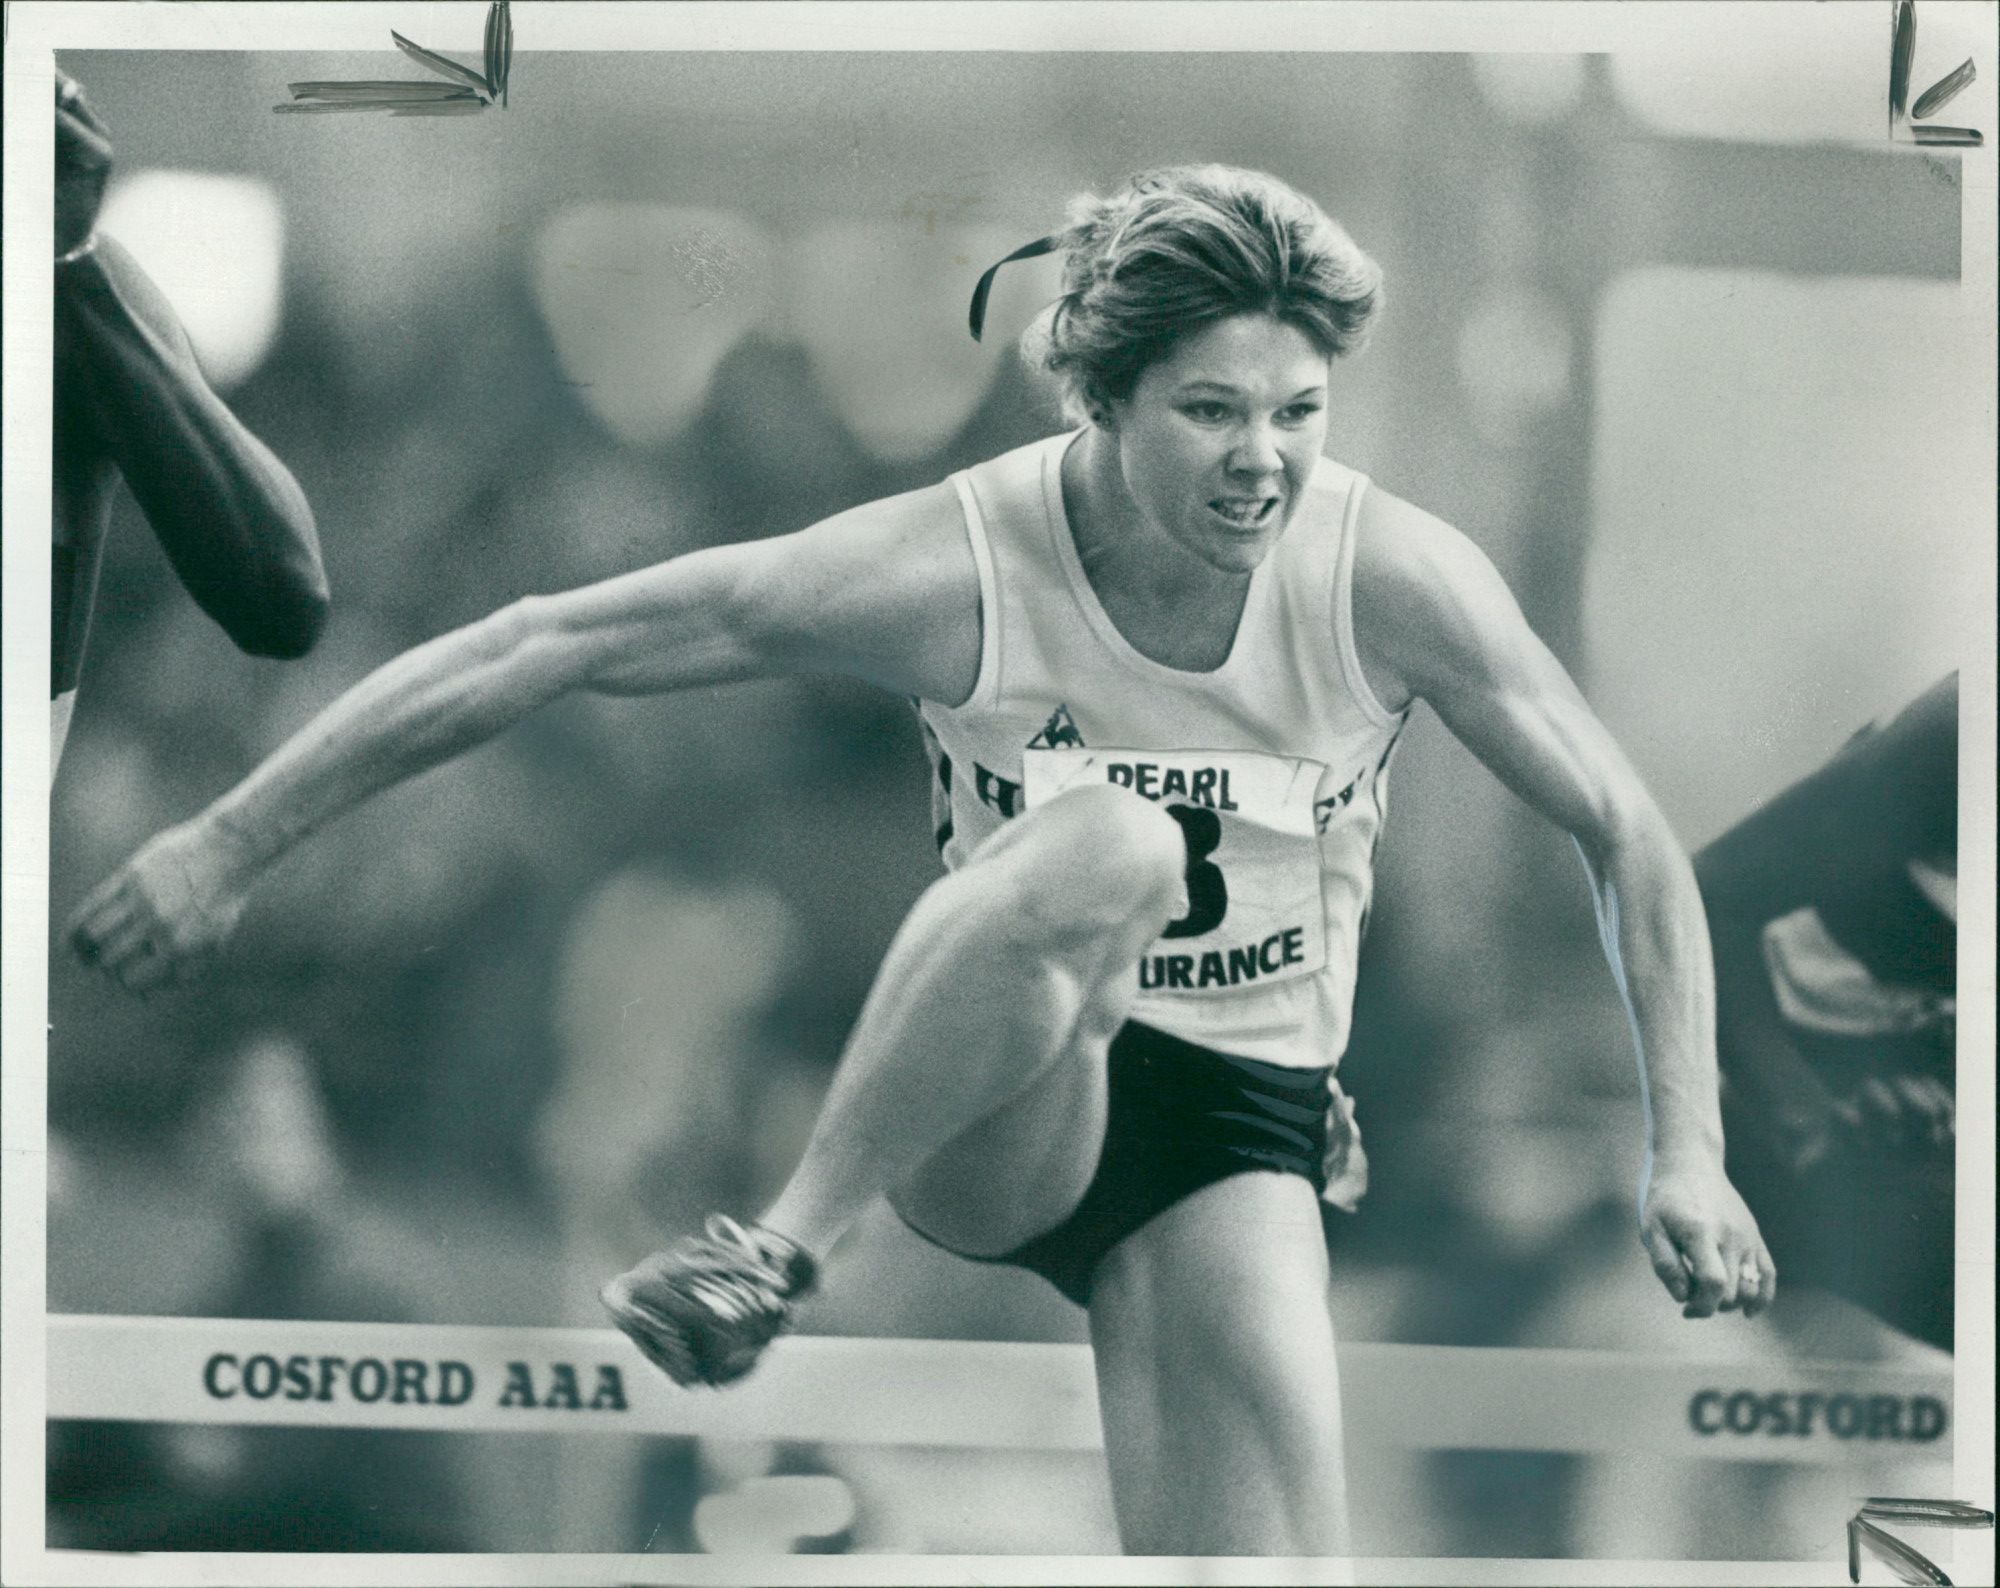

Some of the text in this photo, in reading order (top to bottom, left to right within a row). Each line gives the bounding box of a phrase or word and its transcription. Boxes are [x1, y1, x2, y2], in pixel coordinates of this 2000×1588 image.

[203, 1352, 628, 1411] COSFORD AAA
[1688, 1389, 1947, 1443] COSFORD
